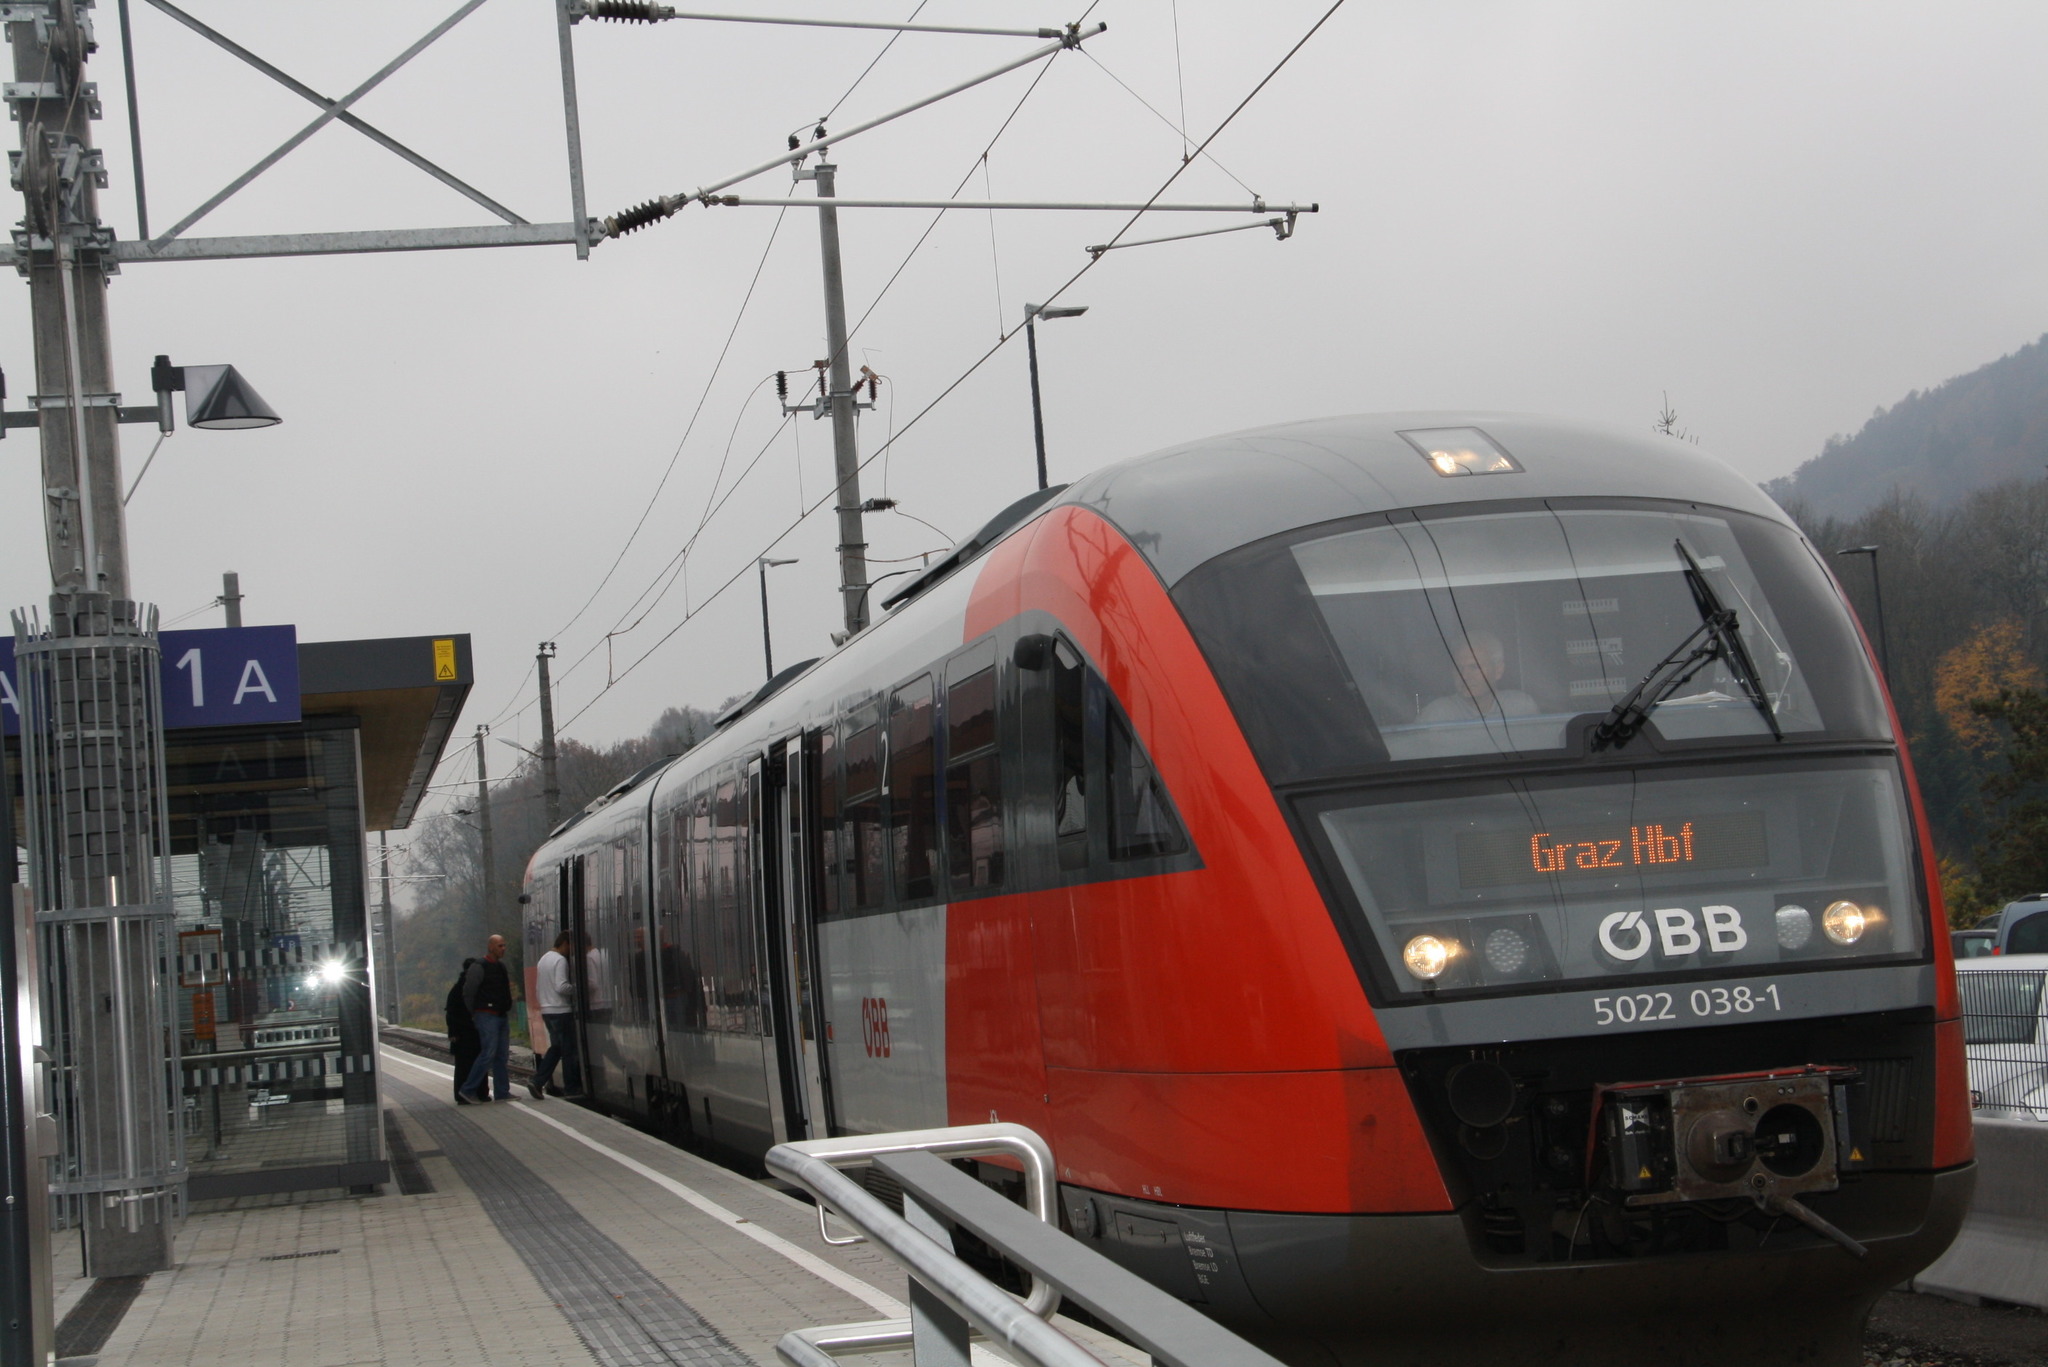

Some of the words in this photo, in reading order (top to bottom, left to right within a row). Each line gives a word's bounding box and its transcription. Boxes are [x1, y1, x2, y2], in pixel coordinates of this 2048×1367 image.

[176, 648, 204, 707] 1
[232, 659, 277, 705] A
[880, 731, 889, 796] 2
[1531, 832, 1623, 872] Graz
[1630, 822, 1693, 865] Hbf
[1598, 904, 1748, 961] ÖBB
[1593, 992, 1676, 1026] 5022
[1690, 983, 1781, 1017] 038-1
